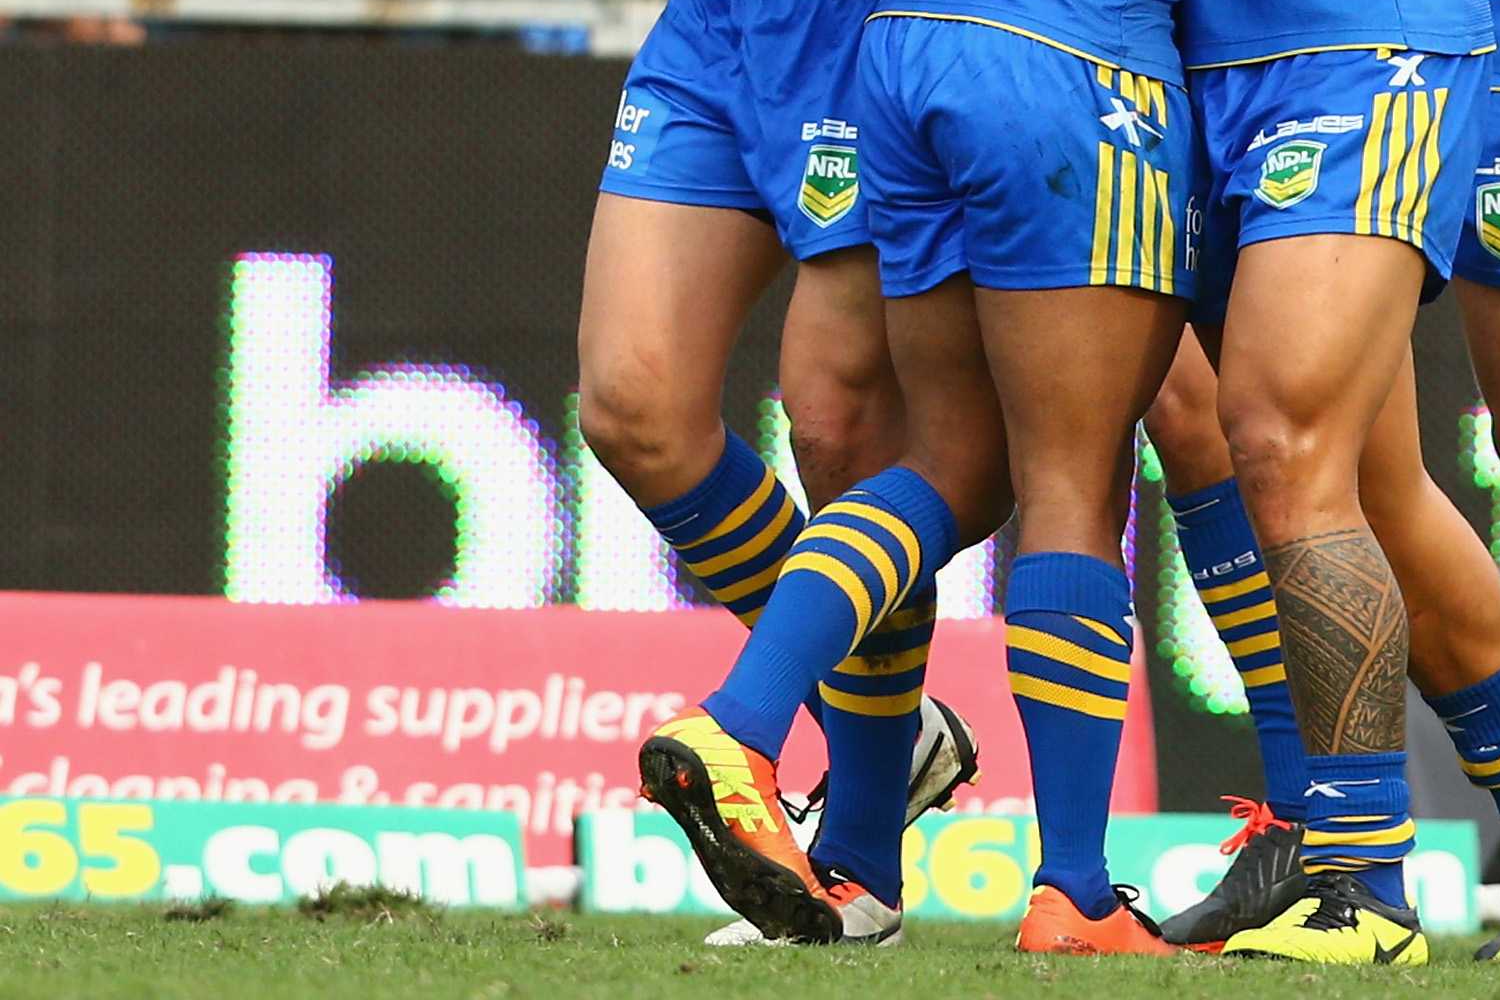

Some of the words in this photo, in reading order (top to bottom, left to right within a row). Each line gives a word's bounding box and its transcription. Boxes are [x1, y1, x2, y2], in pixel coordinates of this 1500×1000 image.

[808, 154, 857, 179] NRL
[77, 661, 351, 752] leading
[366, 674, 687, 754] suppliers
